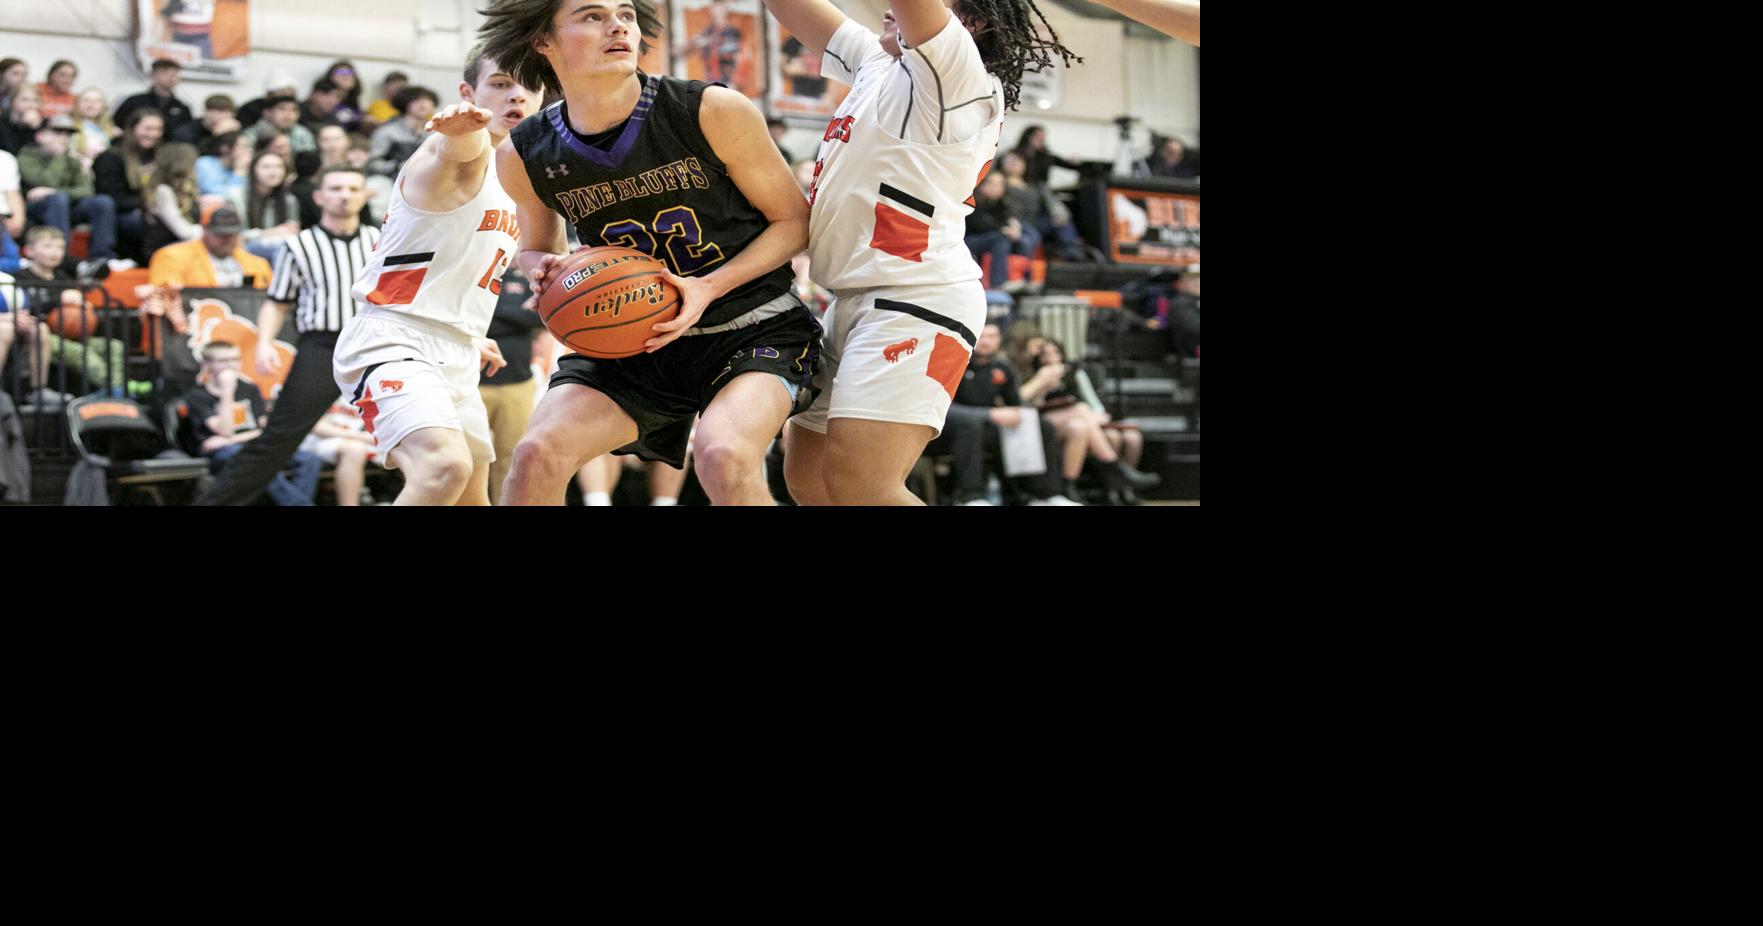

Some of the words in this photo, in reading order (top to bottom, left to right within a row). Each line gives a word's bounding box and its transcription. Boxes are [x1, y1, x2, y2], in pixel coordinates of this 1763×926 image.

[555, 181, 617, 225] PINE
[613, 156, 710, 202] BLUFFS
[476, 208, 521, 241] BRO
[562, 267, 594, 292] PRO
[584, 281, 665, 318] Baden
